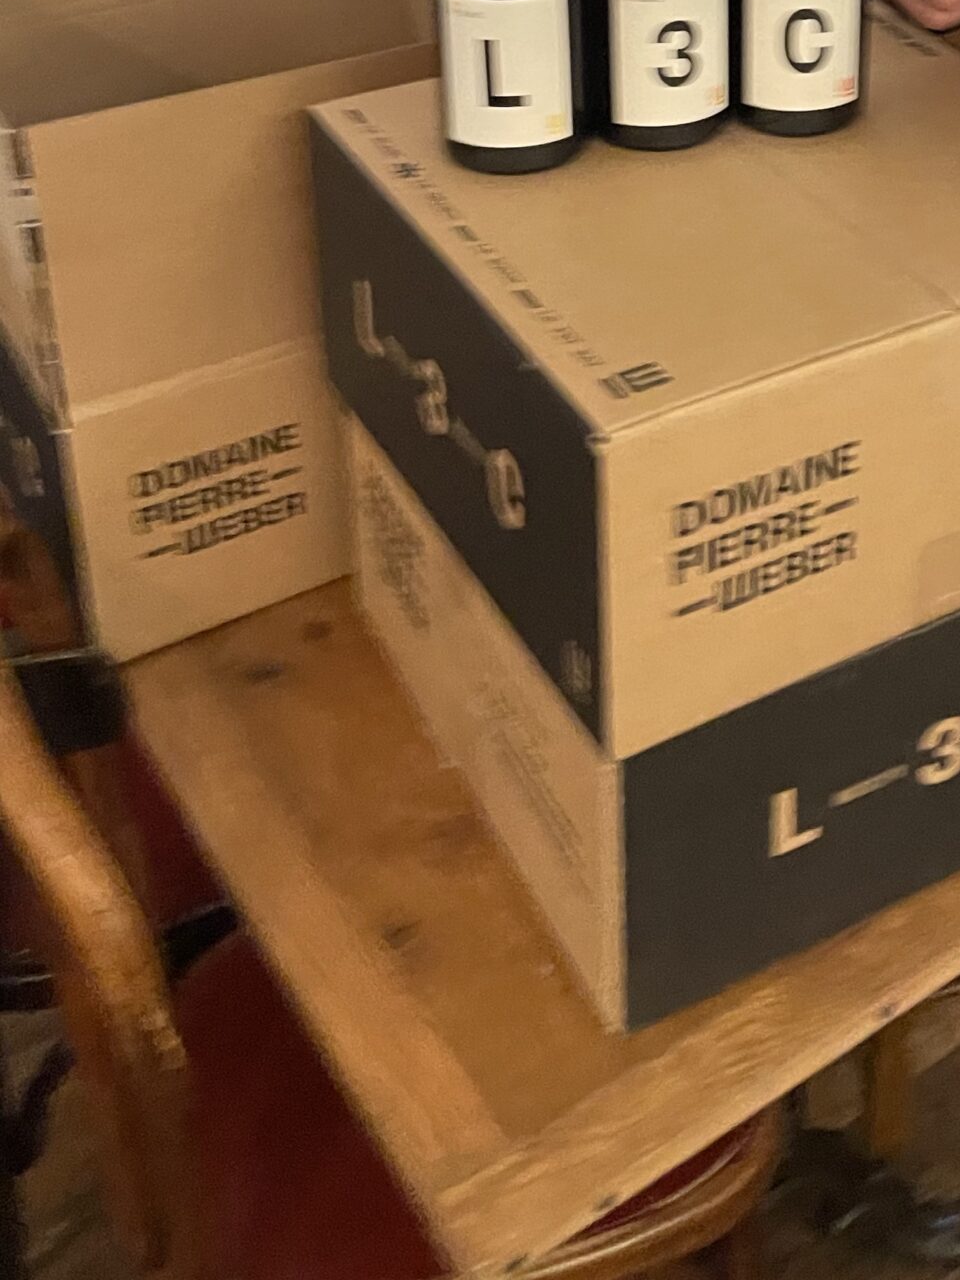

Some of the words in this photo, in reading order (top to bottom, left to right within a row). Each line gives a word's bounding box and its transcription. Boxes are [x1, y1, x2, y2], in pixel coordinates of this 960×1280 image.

[478, 39, 532, 108] L
[656, 20, 695, 88] 3
[784, 8, 833, 74] C
[128, 422, 302, 498] DOMAINE
[670, 440, 862, 538] DOMAINE
